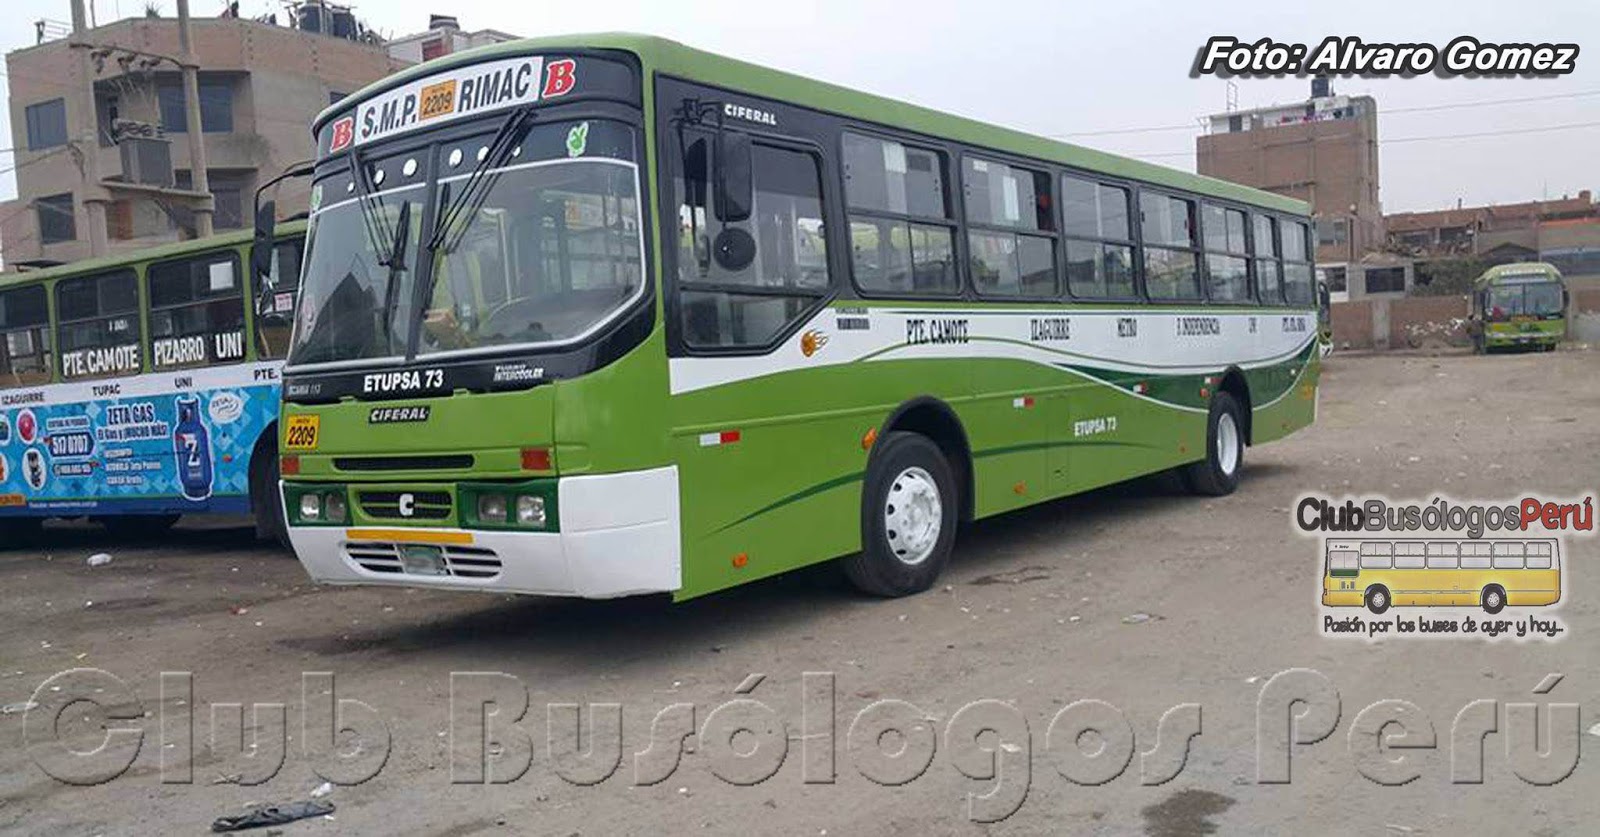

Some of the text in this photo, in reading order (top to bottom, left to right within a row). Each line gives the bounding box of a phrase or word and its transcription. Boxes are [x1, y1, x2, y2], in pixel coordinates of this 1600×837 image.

[541, 60, 576, 98] B
[361, 62, 532, 139] S.M.P. 2209 RIMAC
[724, 103, 777, 125] CIFERAL
[330, 118, 353, 153] B
[931, 320, 969, 344] CAMOTE
[87, 346, 139, 374] CAMOTE
[153, 332, 243, 366] PIZARRO UNI
[92, 384, 121, 396] TUPAC
[174, 377, 193, 389] UNI
[364, 369, 444, 393] ETUPSA 73
[107, 403, 154, 425] ZETA GAS
[370, 407, 429, 423] CIFERAL
[288, 425, 316, 446] 2209
[1074, 418, 1105, 437] ETUPSA
[53, 435, 88, 454] 517 0707
